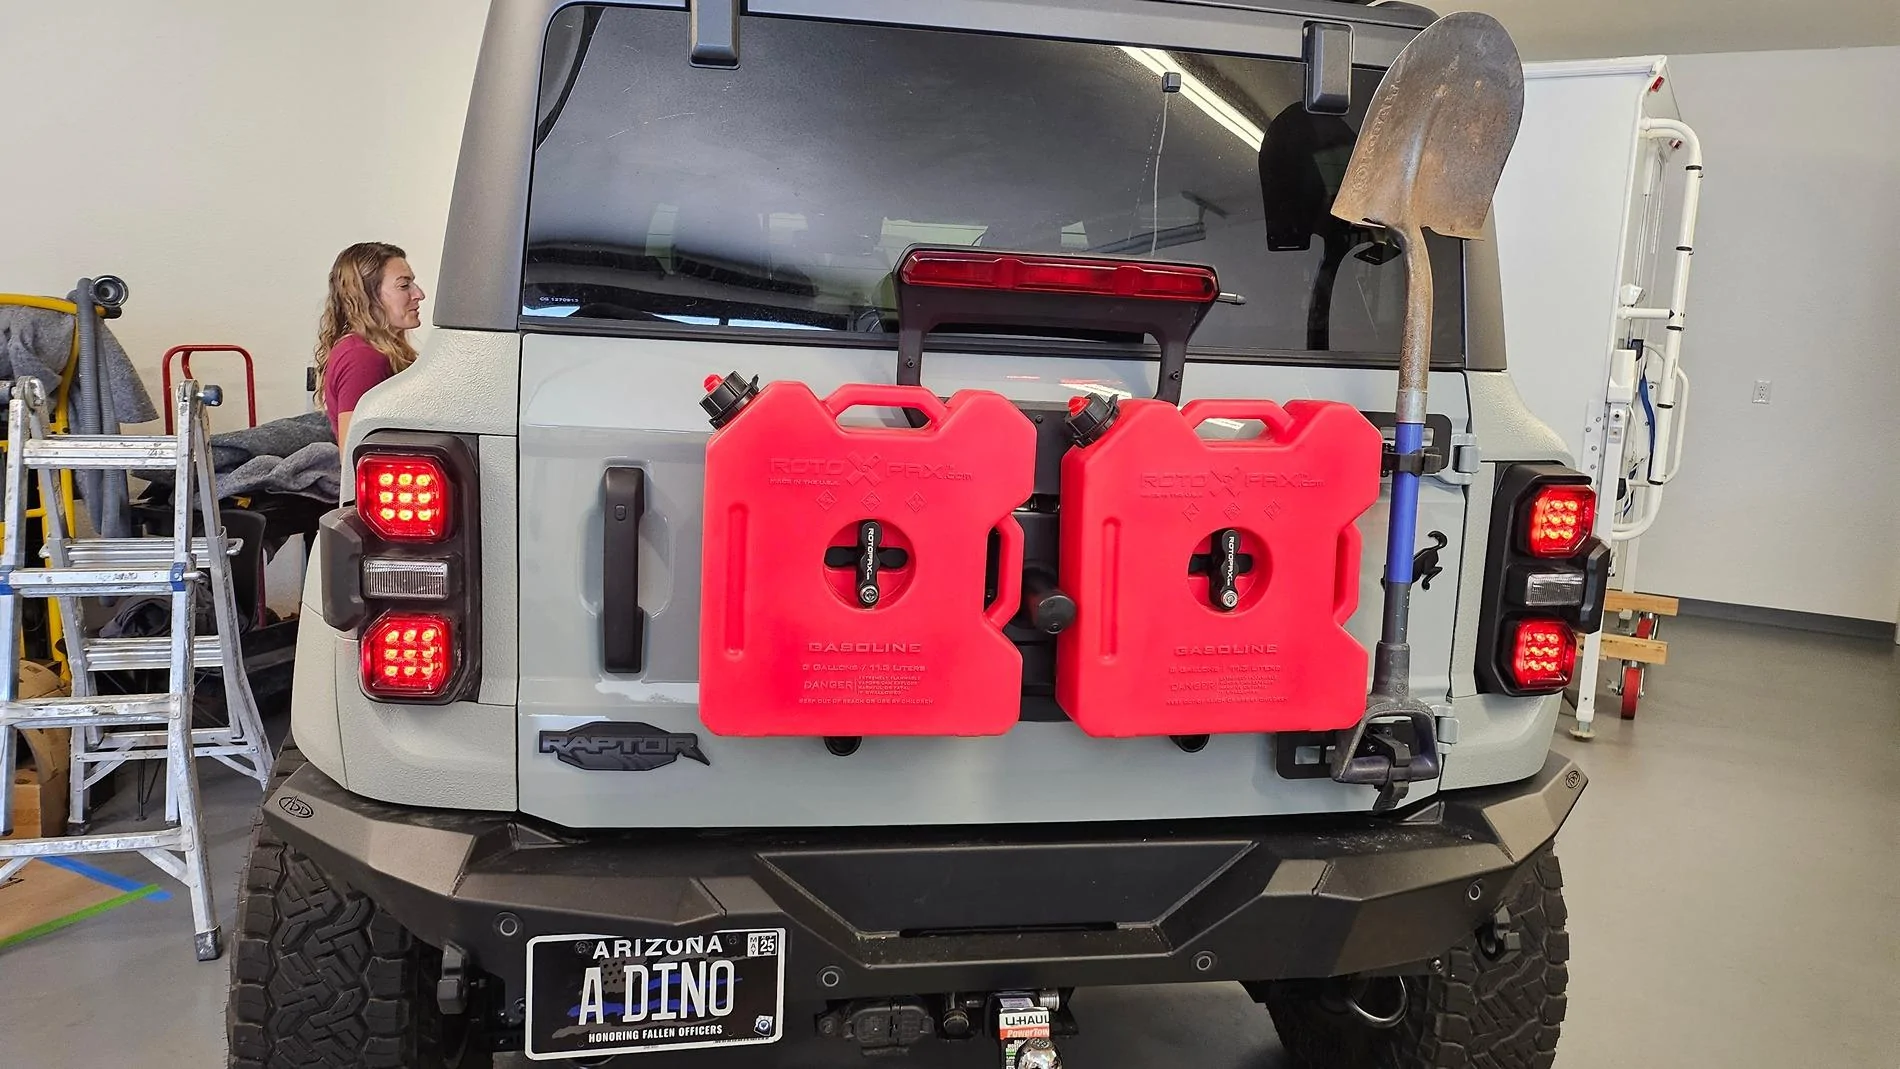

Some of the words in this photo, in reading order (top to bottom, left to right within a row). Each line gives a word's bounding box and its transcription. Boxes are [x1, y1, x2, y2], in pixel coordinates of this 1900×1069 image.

[769, 457, 846, 476] ROTO
[1140, 472, 1207, 488] ROTO
[808, 642, 922, 653] GASOLINE
[1175, 644, 1279, 656] GASOLINE
[804, 680, 853, 690] DANGER
[539, 731, 710, 766] RAPTOR
[593, 935, 723, 959] ARIZONA
[760, 939, 774, 951] 25
[578, 967, 604, 1025] A
[622, 960, 735, 1023] DINO
[1005, 1015, 1050, 1026] U-HAUL
[589, 1031, 639, 1043] HONORING
[642, 1028, 675, 1039] FALLEN
[679, 1025, 723, 1037] OFFICERS
